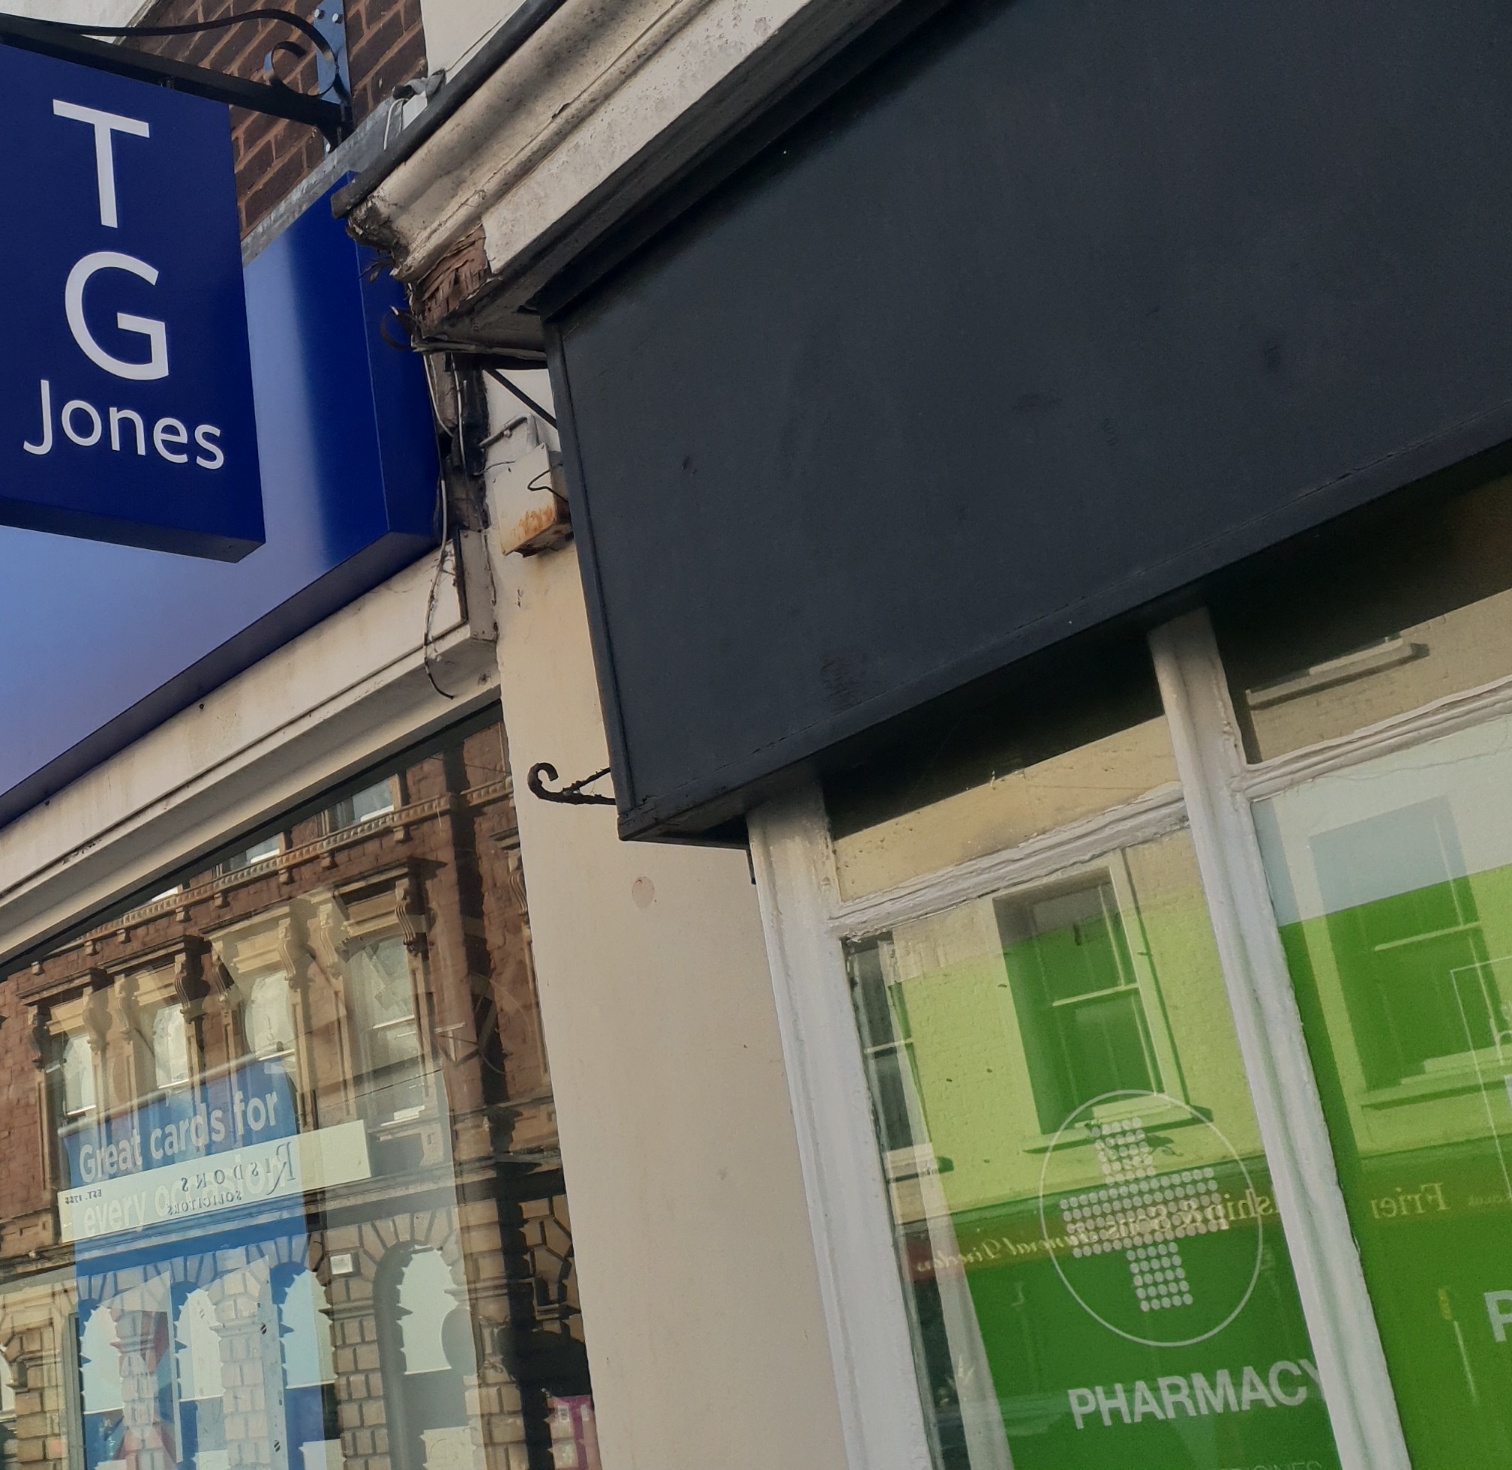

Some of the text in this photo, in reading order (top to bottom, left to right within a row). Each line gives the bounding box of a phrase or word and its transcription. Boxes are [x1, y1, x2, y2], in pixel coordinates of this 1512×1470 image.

[52, 98, 150, 229] T
[64, 250, 170, 381] G
[22, 379, 225, 470] Jones
[79, 1090, 278, 1183] Great cards for
[83, 1187, 148, 1235] every
